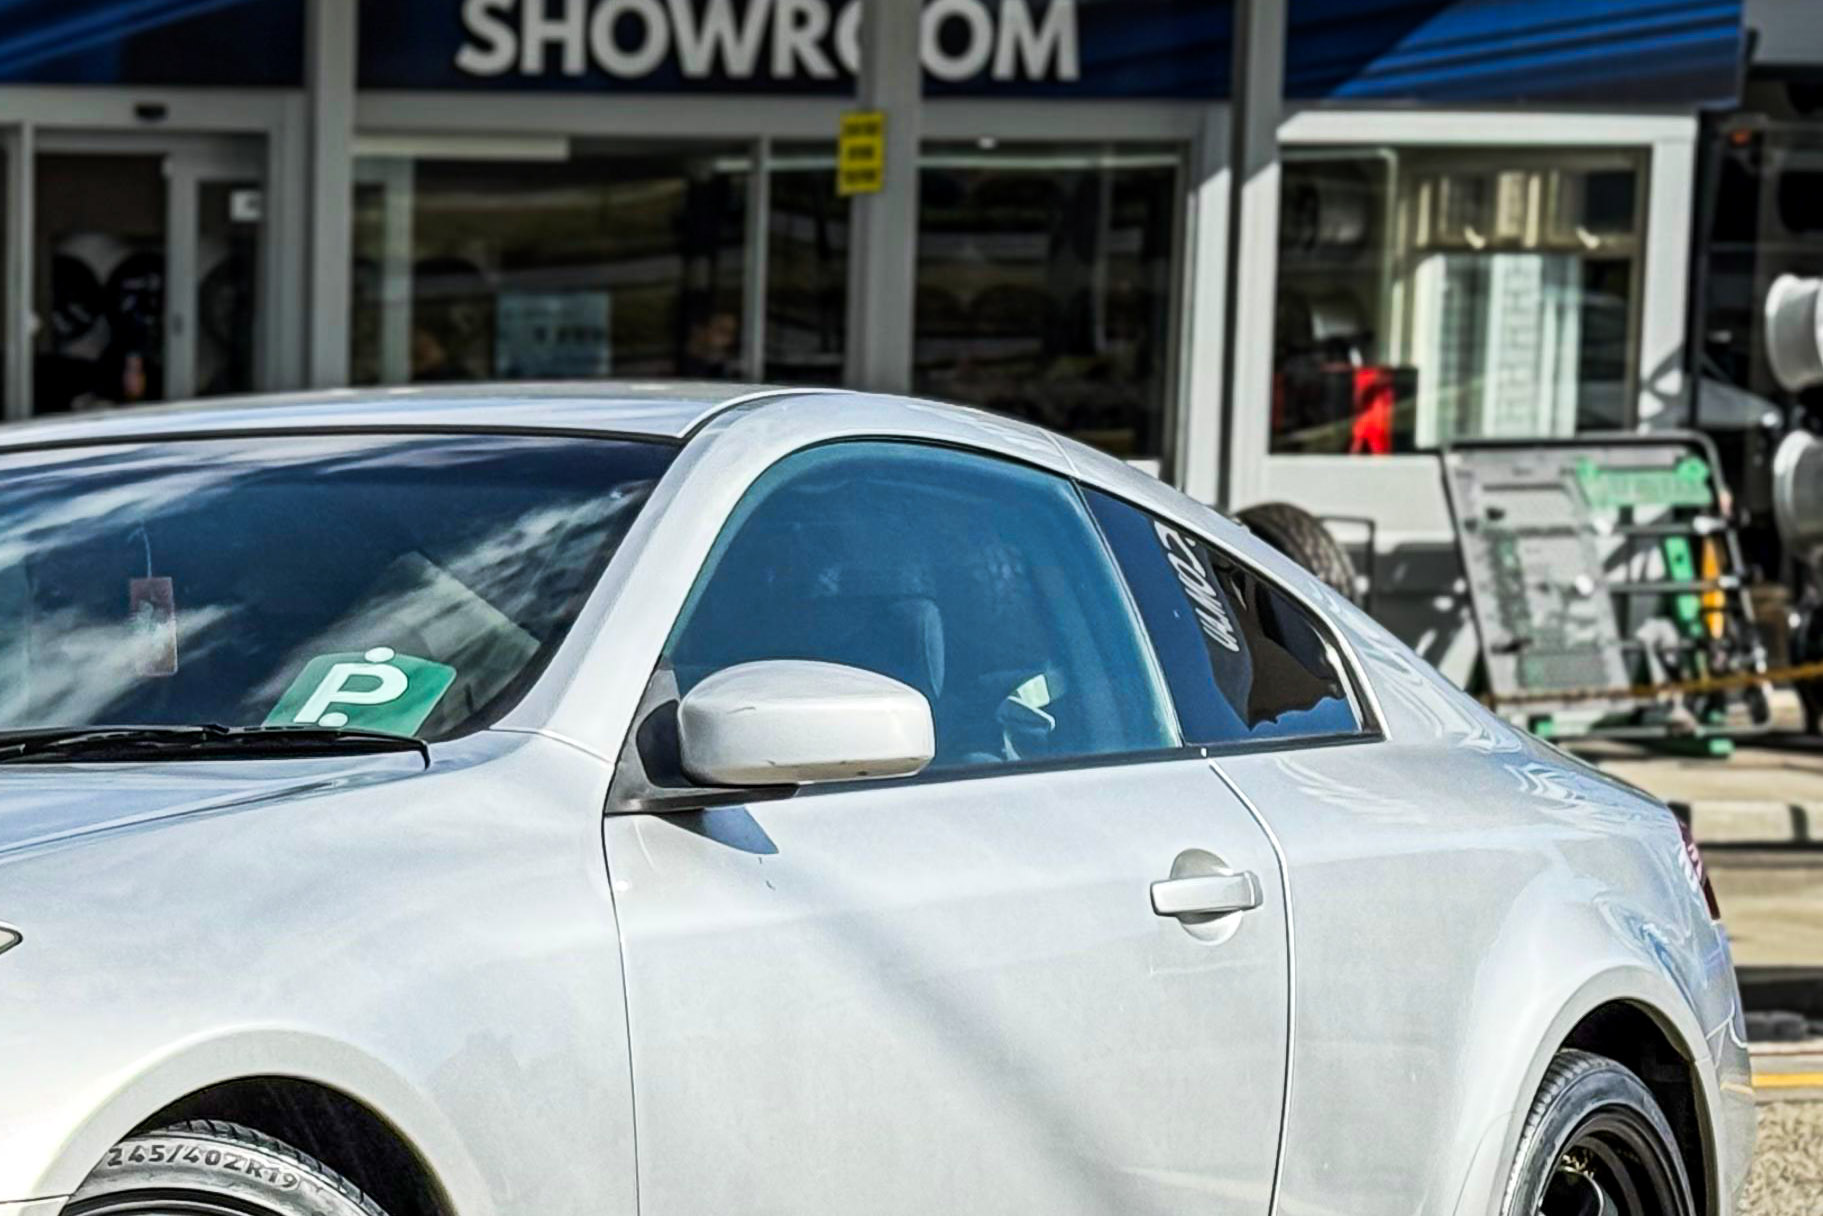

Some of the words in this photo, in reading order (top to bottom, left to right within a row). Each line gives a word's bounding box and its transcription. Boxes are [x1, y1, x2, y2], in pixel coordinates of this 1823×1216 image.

[456, 0, 1082, 81] SHOWROM
[293, 663, 409, 724] P
[106, 1143, 299, 1191] 245/40ZR19
